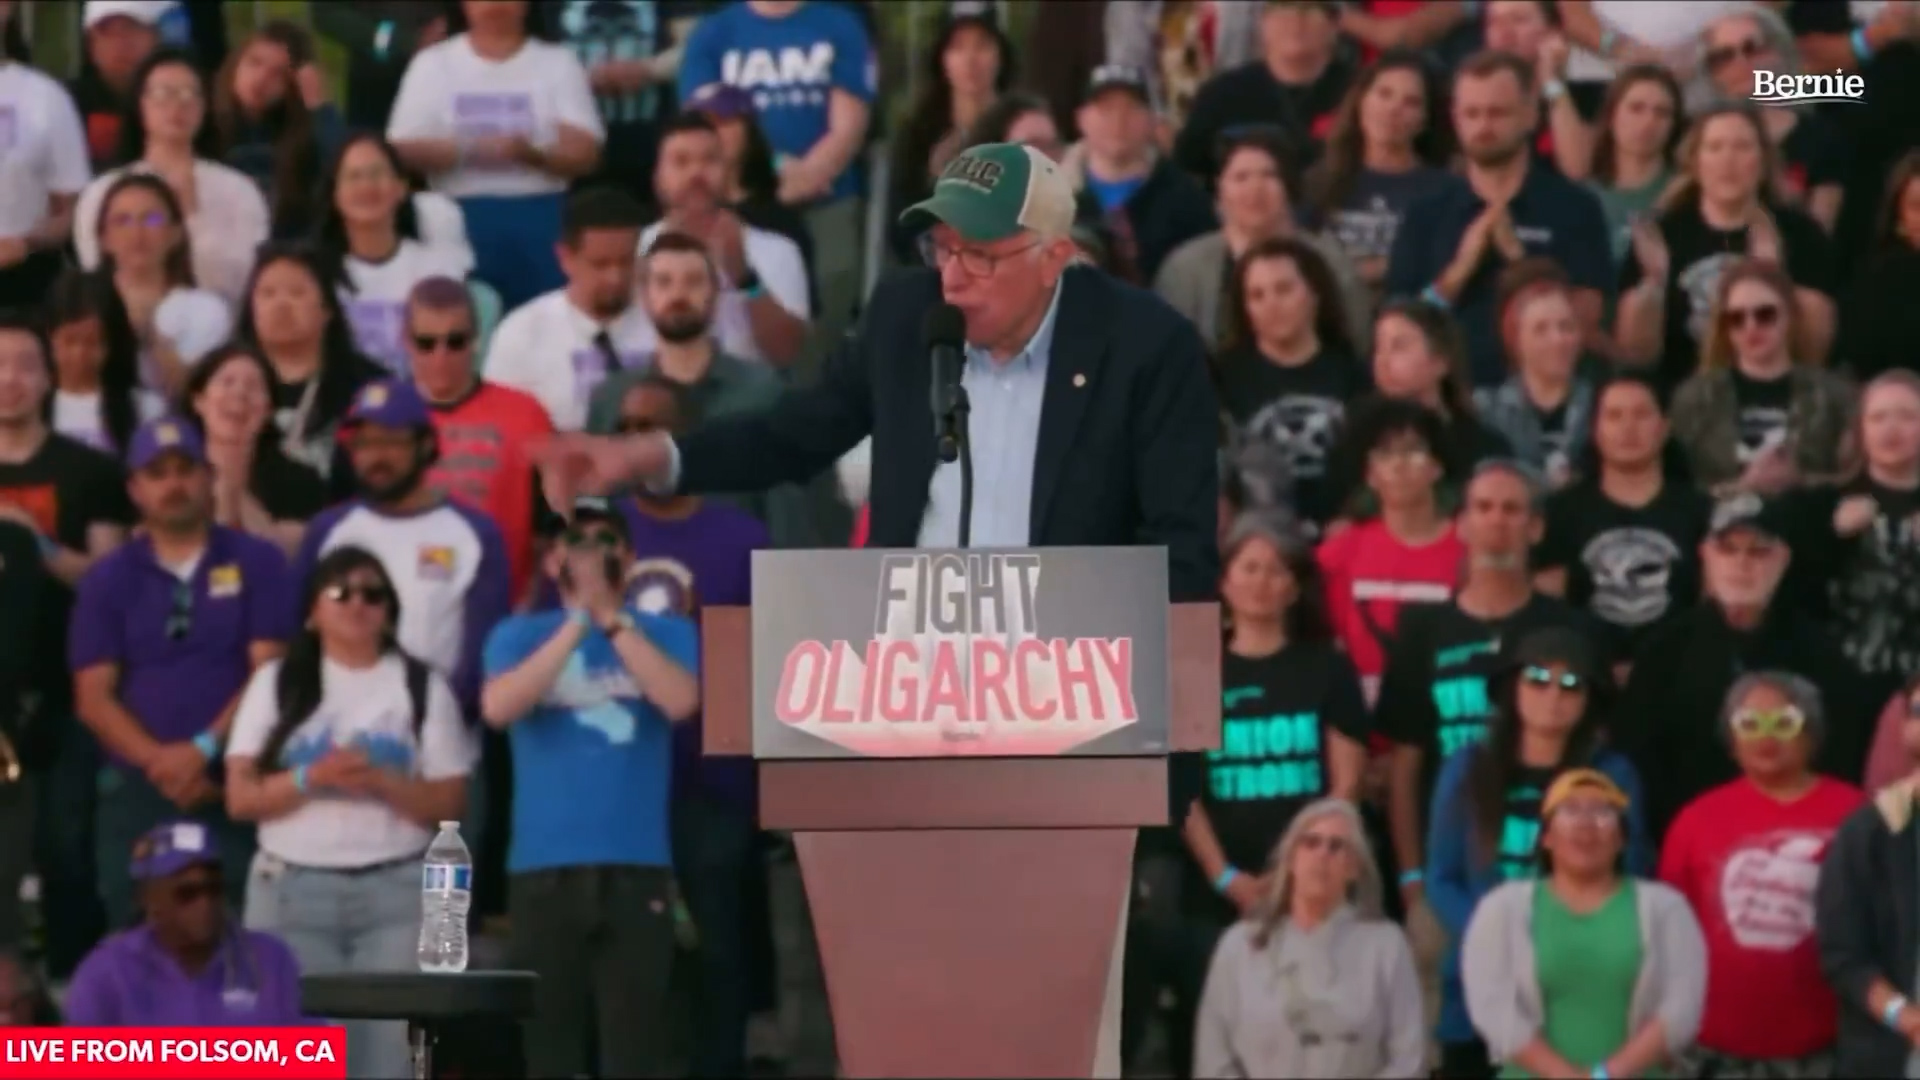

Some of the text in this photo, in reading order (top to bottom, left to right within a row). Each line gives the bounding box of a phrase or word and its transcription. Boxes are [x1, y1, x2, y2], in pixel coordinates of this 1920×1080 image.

[874, 553, 1041, 635] FIGHT
[775, 637, 1139, 724] OLIGARCHY
[1209, 760, 1320, 800] STRONG
